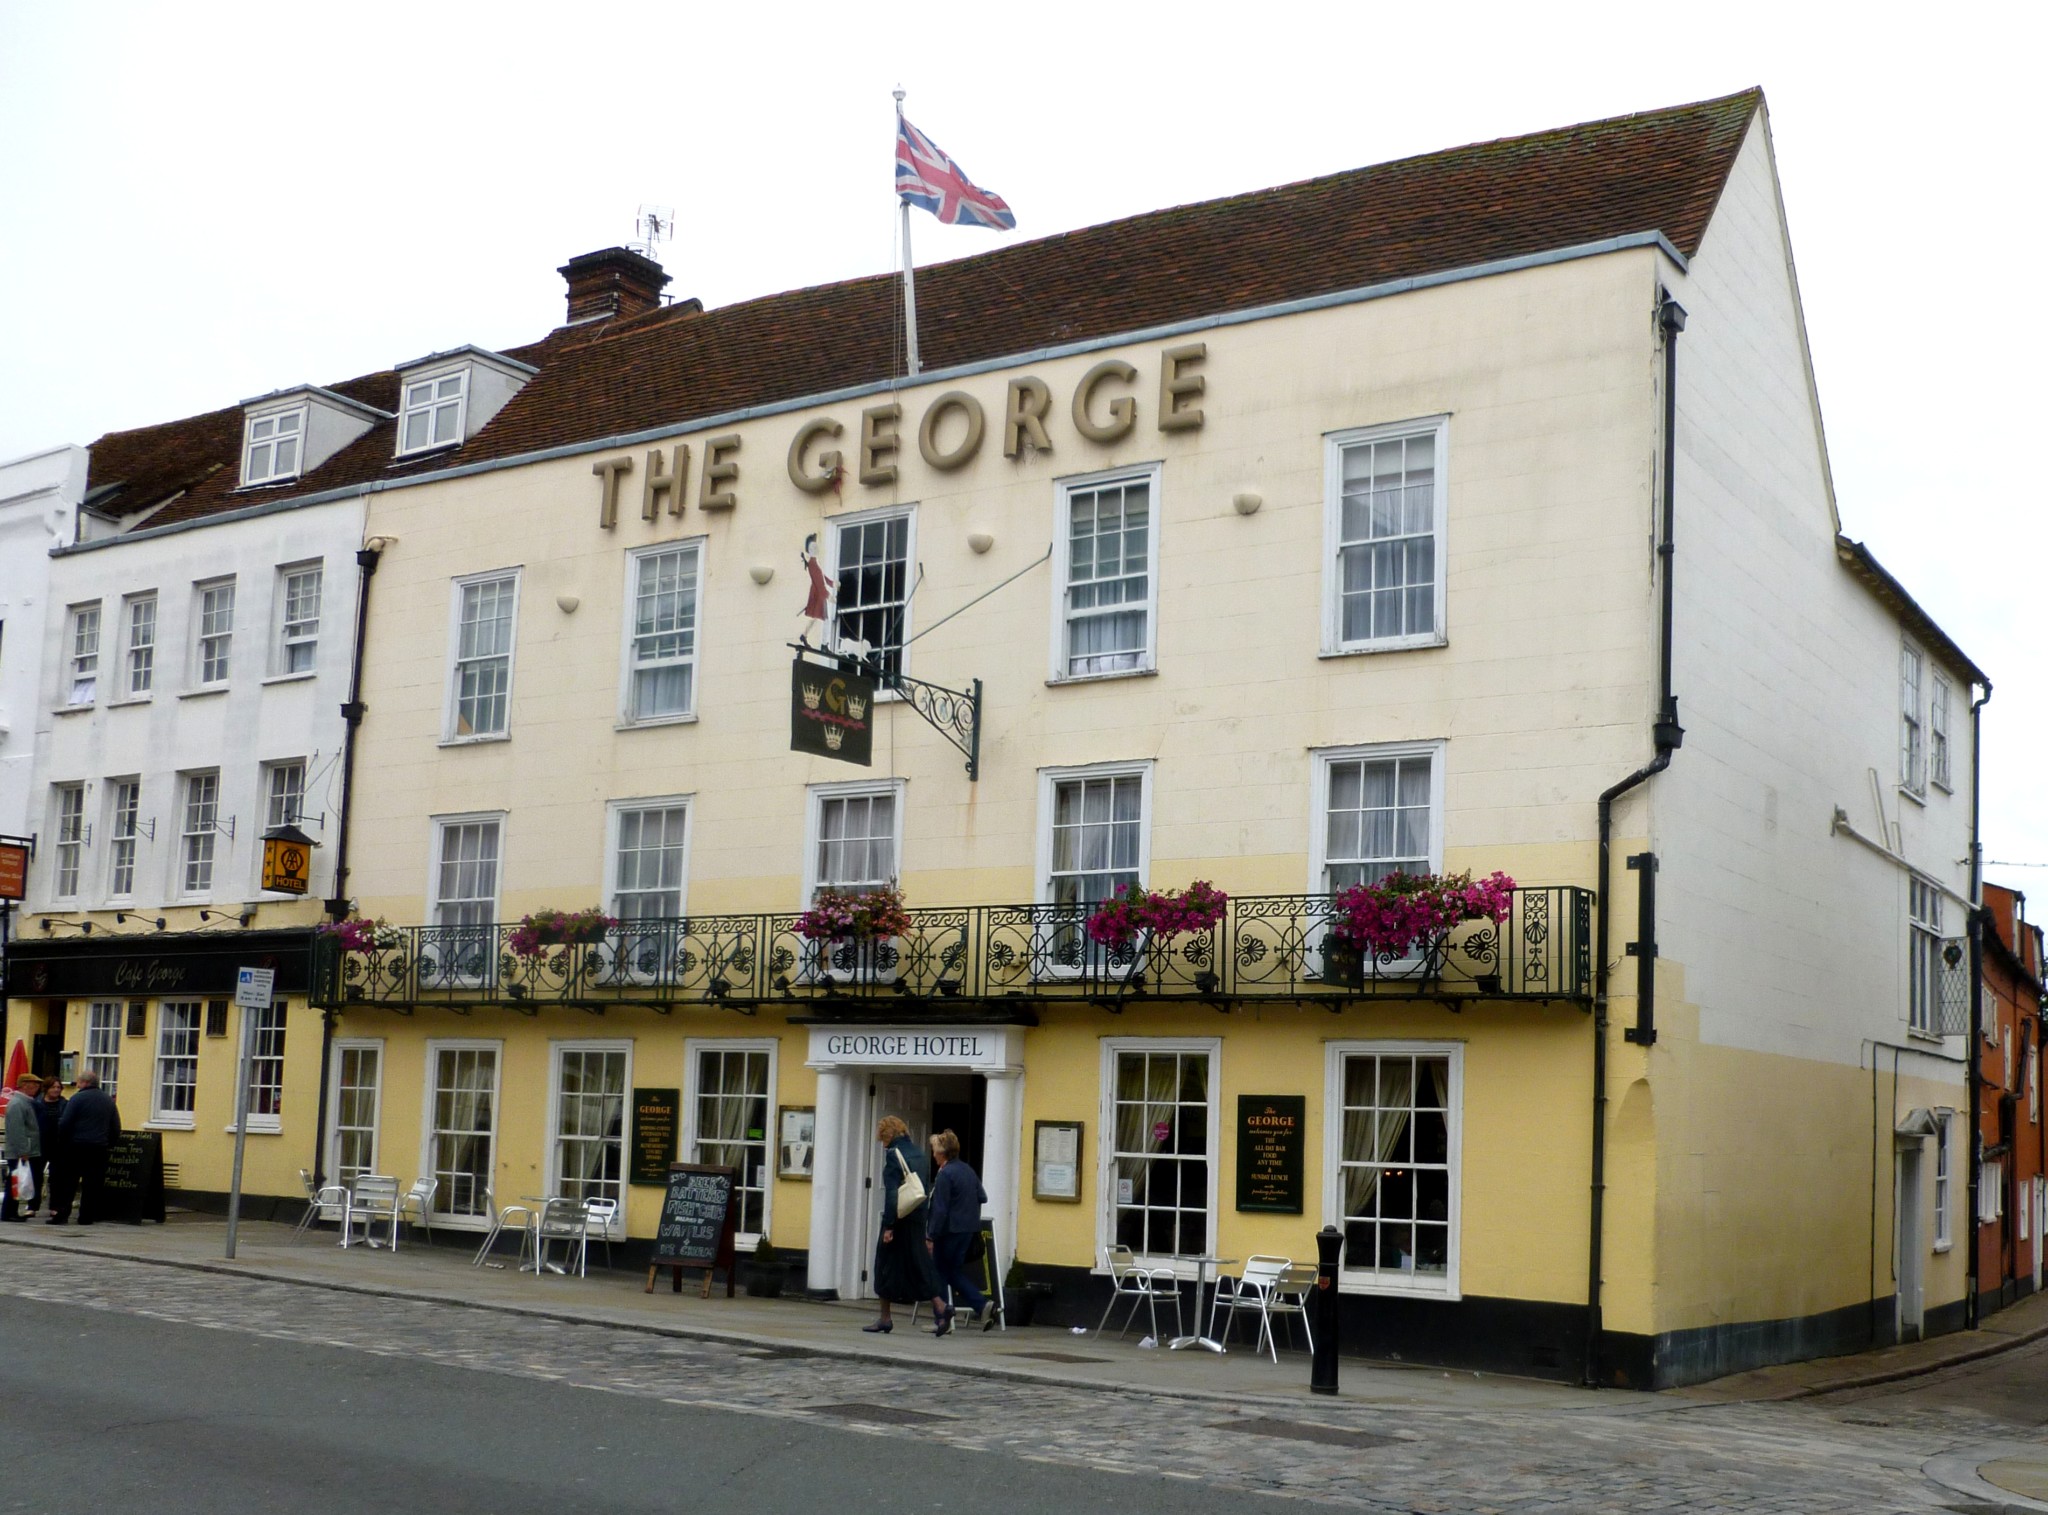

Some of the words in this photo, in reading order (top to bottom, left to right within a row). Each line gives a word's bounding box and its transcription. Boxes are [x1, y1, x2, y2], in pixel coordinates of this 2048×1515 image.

[592, 433, 742, 530] THE
[787, 341, 1207, 494] GEORGE
[275, 876, 304, 890] HOTEL
[115, 960, 143, 988] Cafe
[147, 959, 186, 988] George
[828, 1035, 907, 1055] GEORGE
[913, 1036, 983, 1057] HOTEL
[639, 1105, 672, 1114] GEORGE
[1247, 1116, 1295, 1126] GEORGE
[688, 1175, 717, 1189] BEER
[670, 1186, 728, 1204] BATTERED
[667, 1199, 695, 1217] FISH
[660, 1223, 715, 1240] WAFFLES
